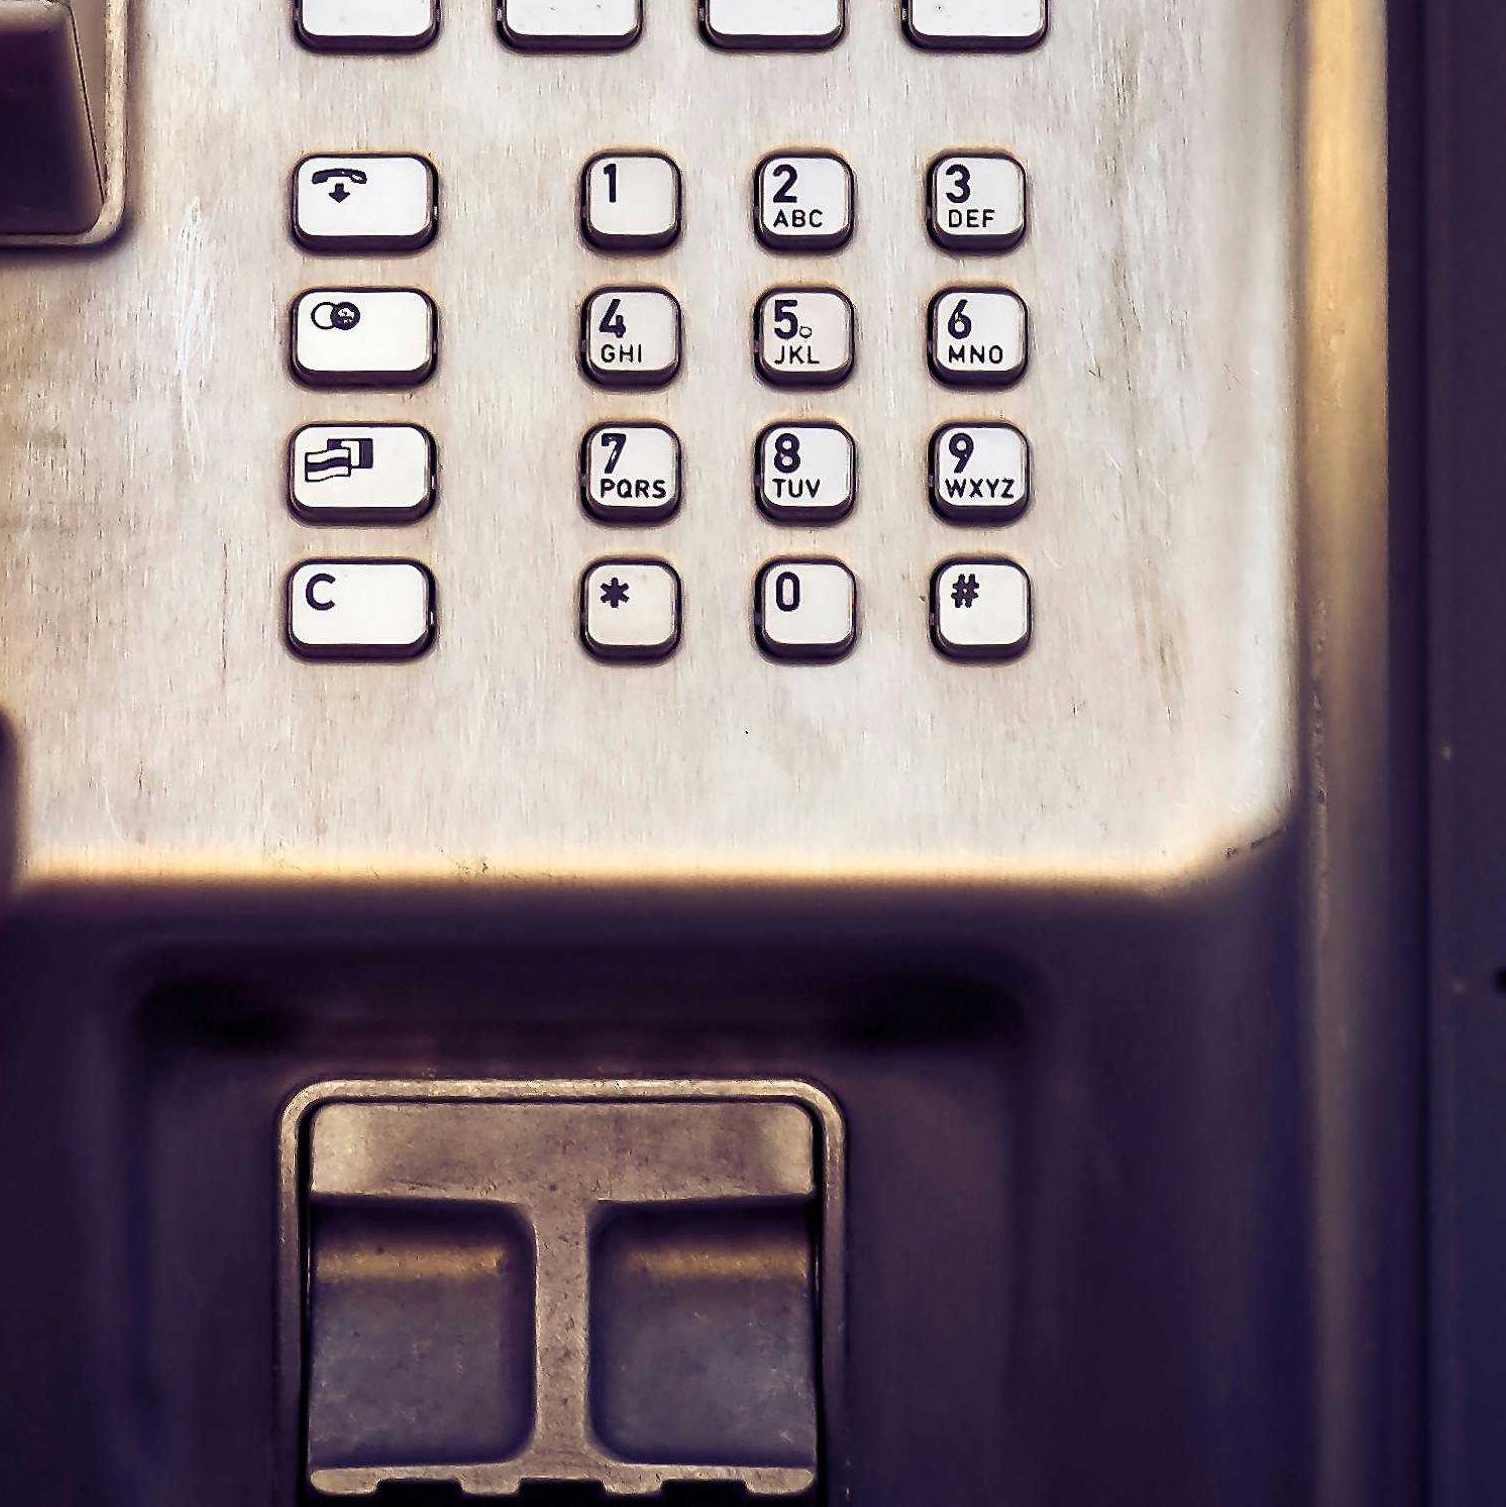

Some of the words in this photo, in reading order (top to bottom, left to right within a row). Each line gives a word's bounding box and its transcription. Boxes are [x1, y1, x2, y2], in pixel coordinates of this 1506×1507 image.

[600, 163, 619, 205] 1
[771, 163, 799, 205] 2
[945, 163, 971, 205] 3
[771, 208, 824, 229] ABC
[947, 208, 997, 229] DEF
[597, 298, 627, 340] 4
[772, 299, 800, 341] 5
[946, 298, 973, 341] 6
[599, 343, 643, 364] GHI
[772, 344, 821, 365] JKL
[947, 343, 1005, 365] MNO
[599, 432, 627, 475] 7
[772, 432, 801, 475] 8
[947, 432, 976, 475] 9
[599, 477, 668, 500] PQRS
[771, 477, 822, 499] TUV
[944, 477, 1016, 500] WXYZ
[304, 572, 337, 612] C
[774, 571, 801, 613] 0
[949, 573, 981, 610] #
